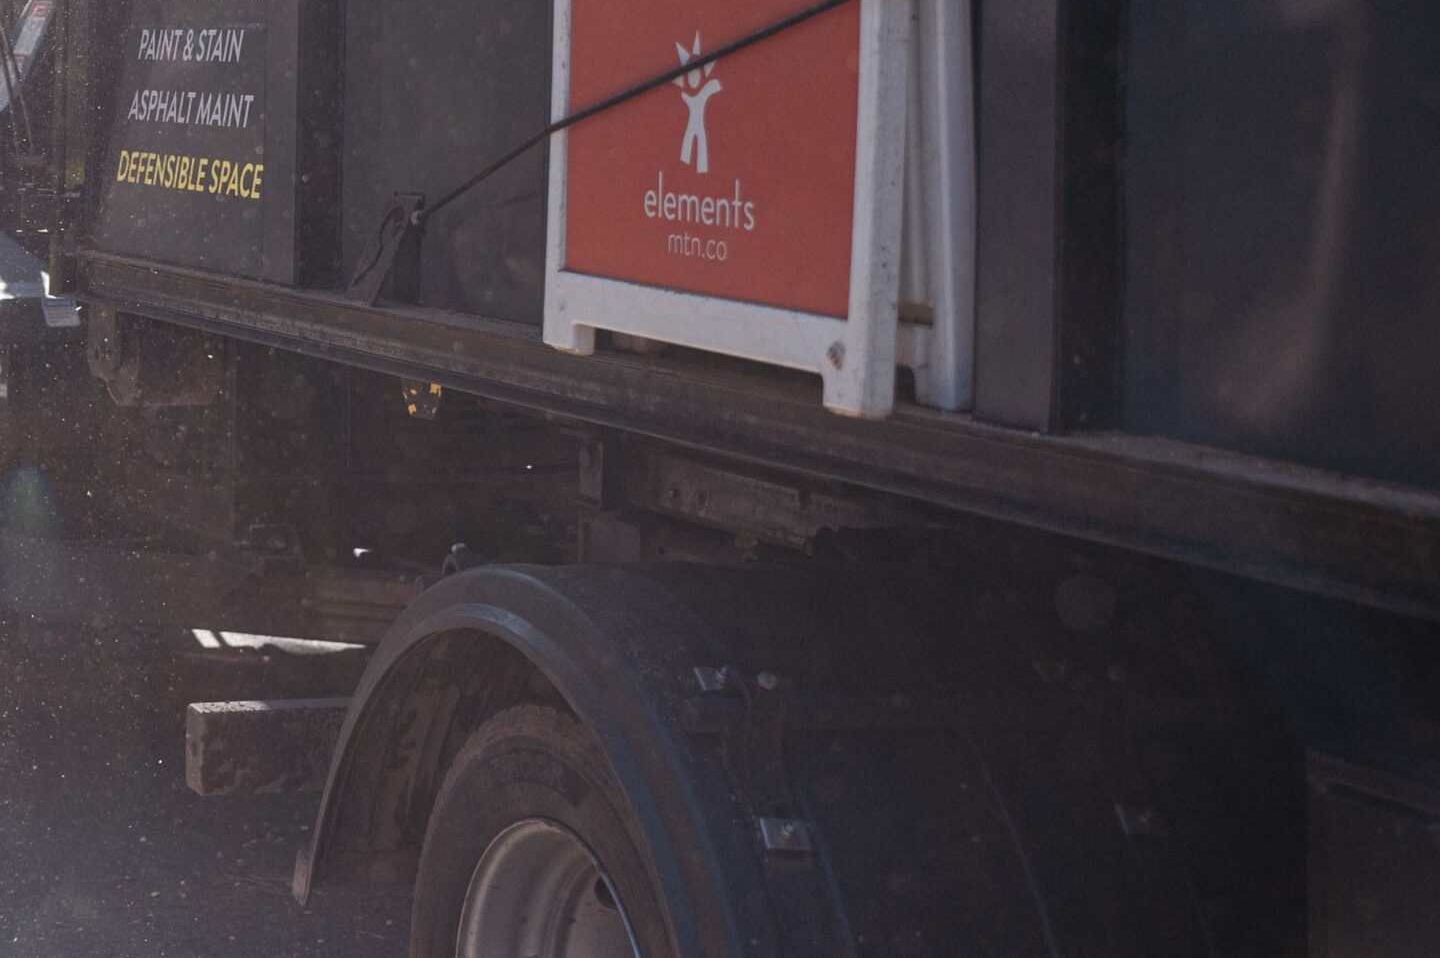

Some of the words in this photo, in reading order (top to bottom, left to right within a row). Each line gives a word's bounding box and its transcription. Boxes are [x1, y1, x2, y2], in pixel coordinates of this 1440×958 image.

[138, 29, 184, 61] PAINT
[182, 28, 195, 62] &
[196, 29, 244, 63] STAIN
[128, 89, 196, 124] ASPHALT
[195, 93, 254, 129] MAINT
[117, 150, 209, 192] DEFENSIBLE
[209, 159, 264, 199] SPACE
[643, 170, 755, 231] elements
[667, 231, 728, 261] mtn.co
